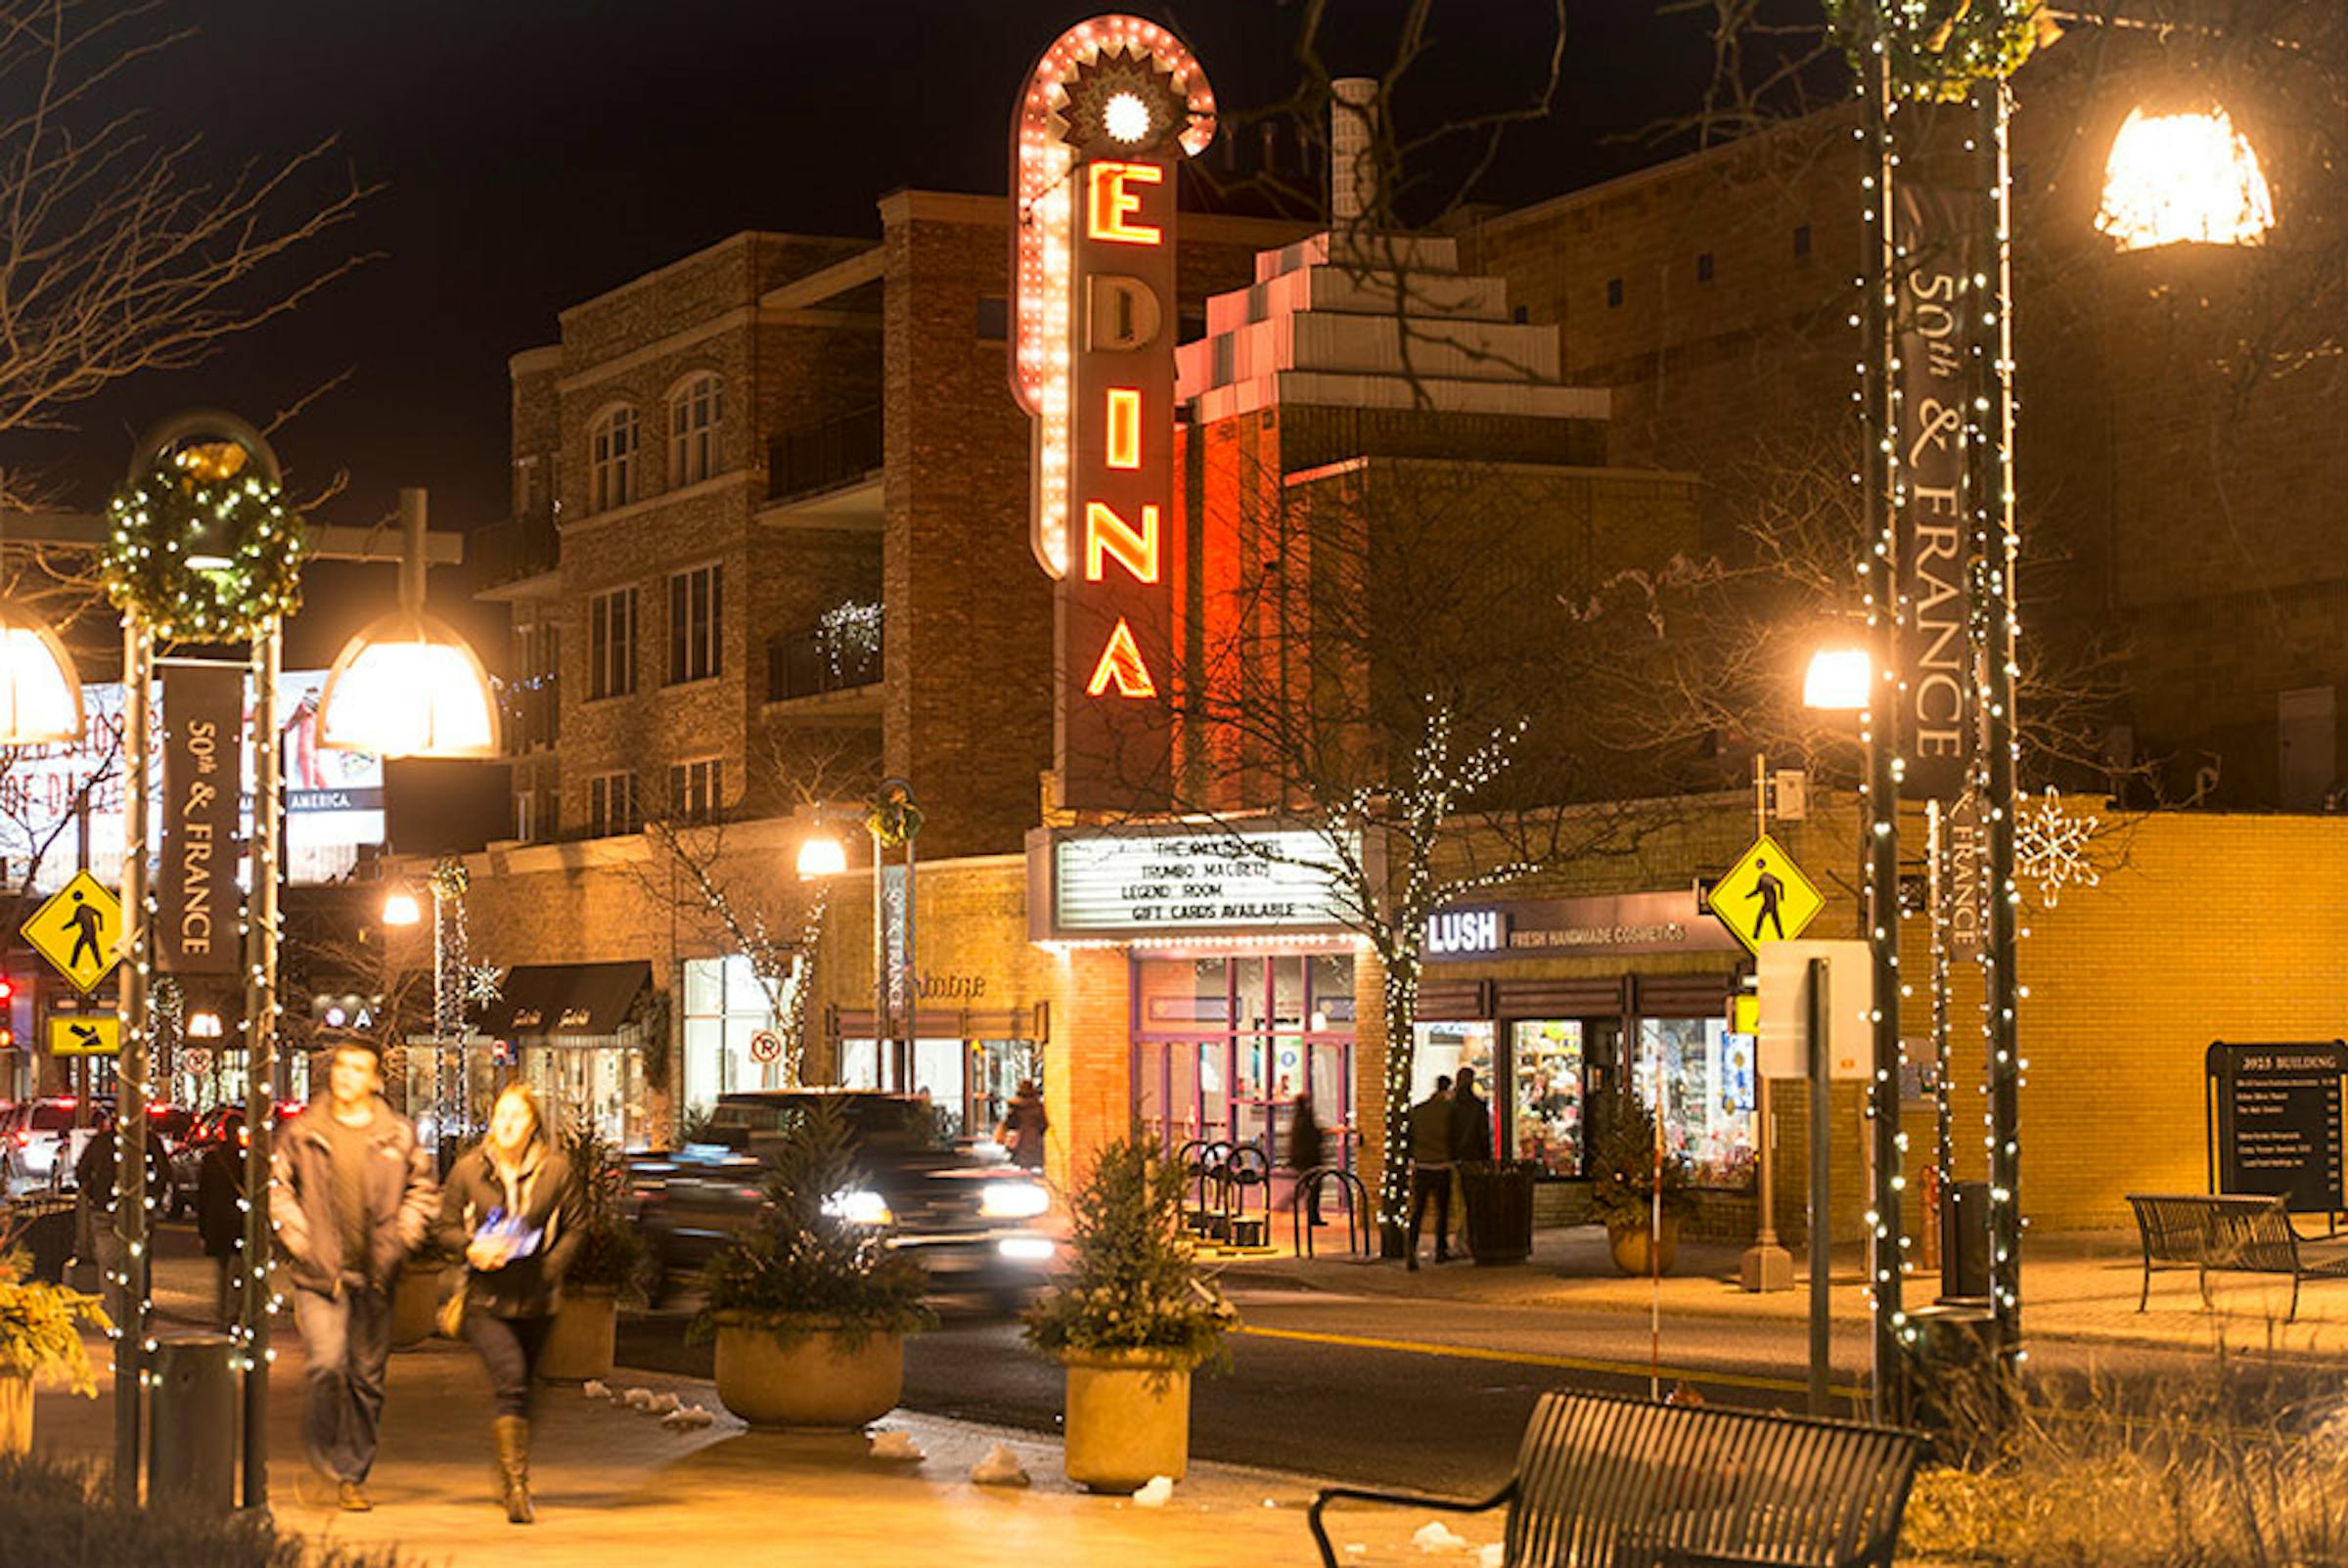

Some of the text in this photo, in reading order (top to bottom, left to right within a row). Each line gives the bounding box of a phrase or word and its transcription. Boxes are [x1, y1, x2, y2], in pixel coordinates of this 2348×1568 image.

[1086, 160, 1164, 698] EDINA
[1909, 268, 1963, 757] 50th & FRANCE
[182, 719, 217, 954] 50th & FRANCE
[1142, 864, 1195, 879] TRUMBO
[1953, 827, 1976, 943] FRANCE
[1121, 882, 1223, 900] LEGEND ROOM
[1132, 902, 1295, 920] GIFT CARDS AVAILABLE
[1429, 911, 1496, 952] LUSH
[1510, 931, 1547, 948] FRESH
[2277, 1054, 2337, 1071] BUILDING
